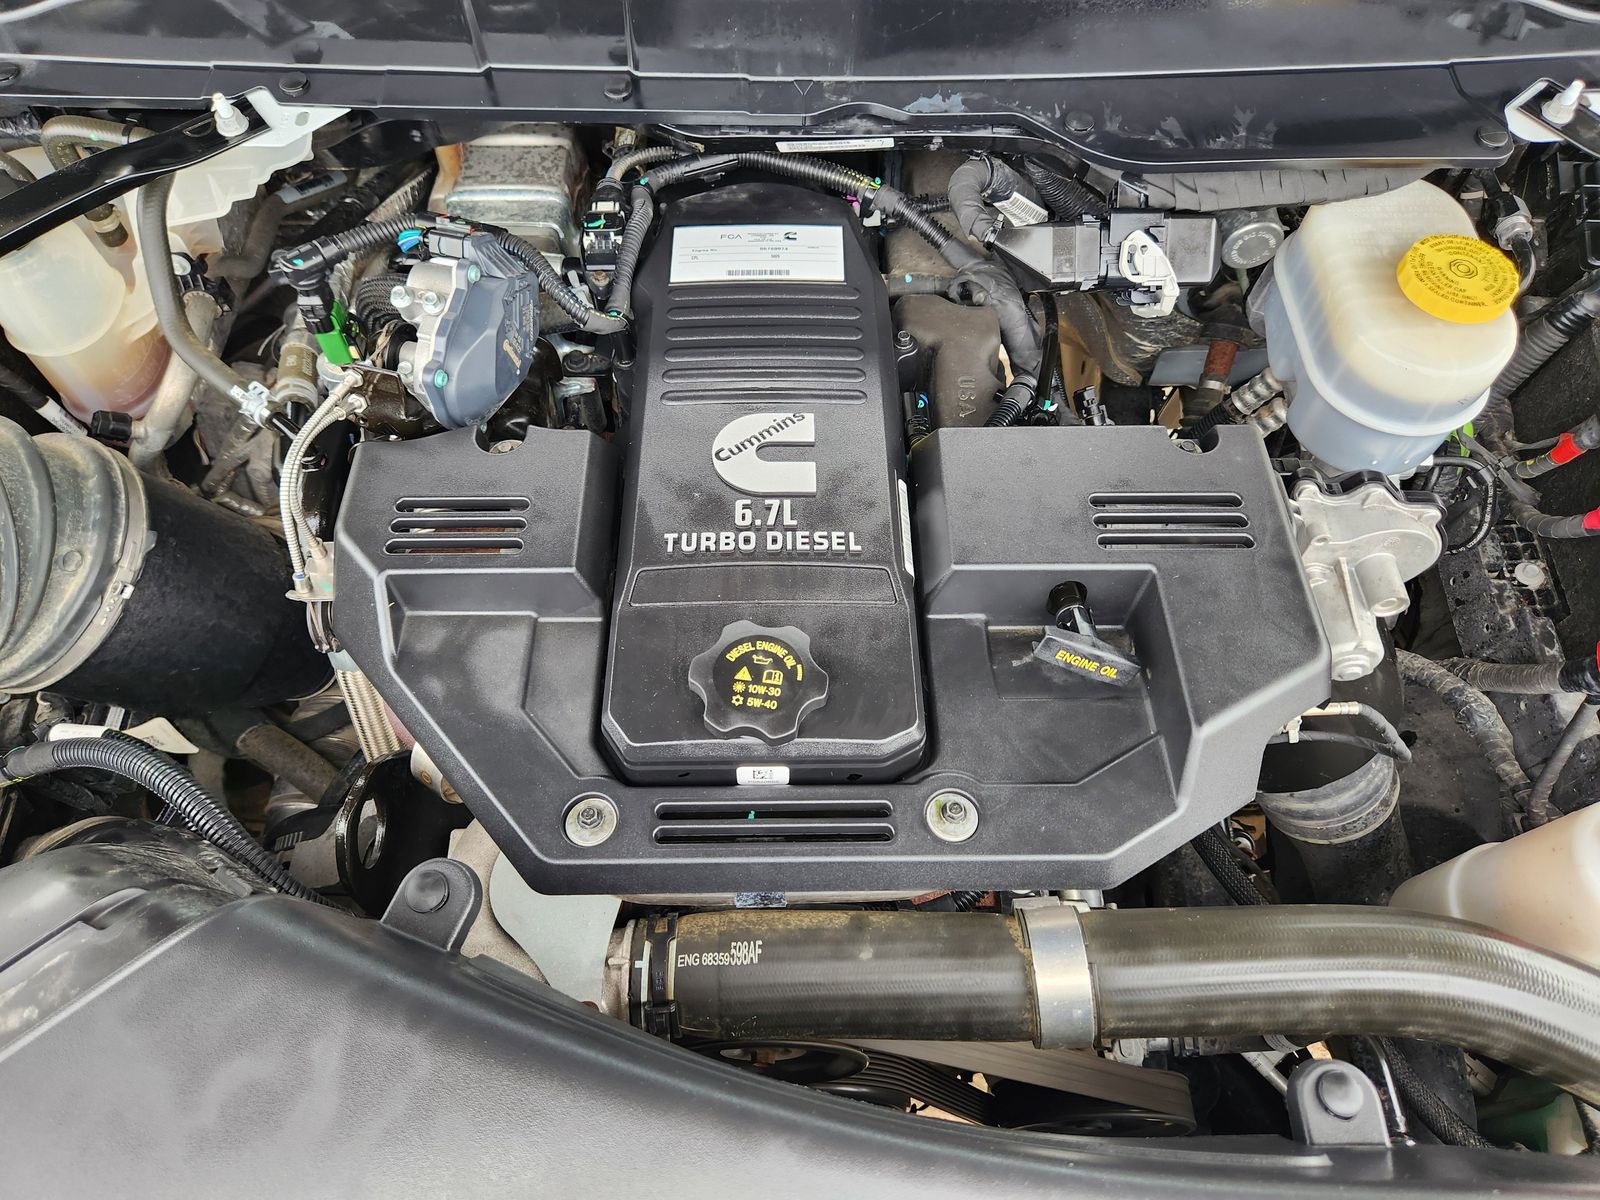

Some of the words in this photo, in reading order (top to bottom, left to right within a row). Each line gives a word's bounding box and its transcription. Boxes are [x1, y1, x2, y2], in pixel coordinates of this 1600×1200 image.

[714, 412, 806, 462] Cummins
[734, 499, 799, 528] 6.7L
[664, 531, 756, 554] TURBO
[766, 531, 863, 554] DIESEL
[725, 642, 755, 662] DIESEL
[756, 640, 788, 658] ENGINE
[783, 655, 797, 670] OIL
[1055, 649, 1100, 672] ENGINE
[1100, 666, 1118, 678] OIL
[746, 697, 778, 710] 5W-40
[748, 684, 782, 697] 10W-30
[677, 953, 700, 967] ENG
[702, 940, 763, 966] 68359598AF
